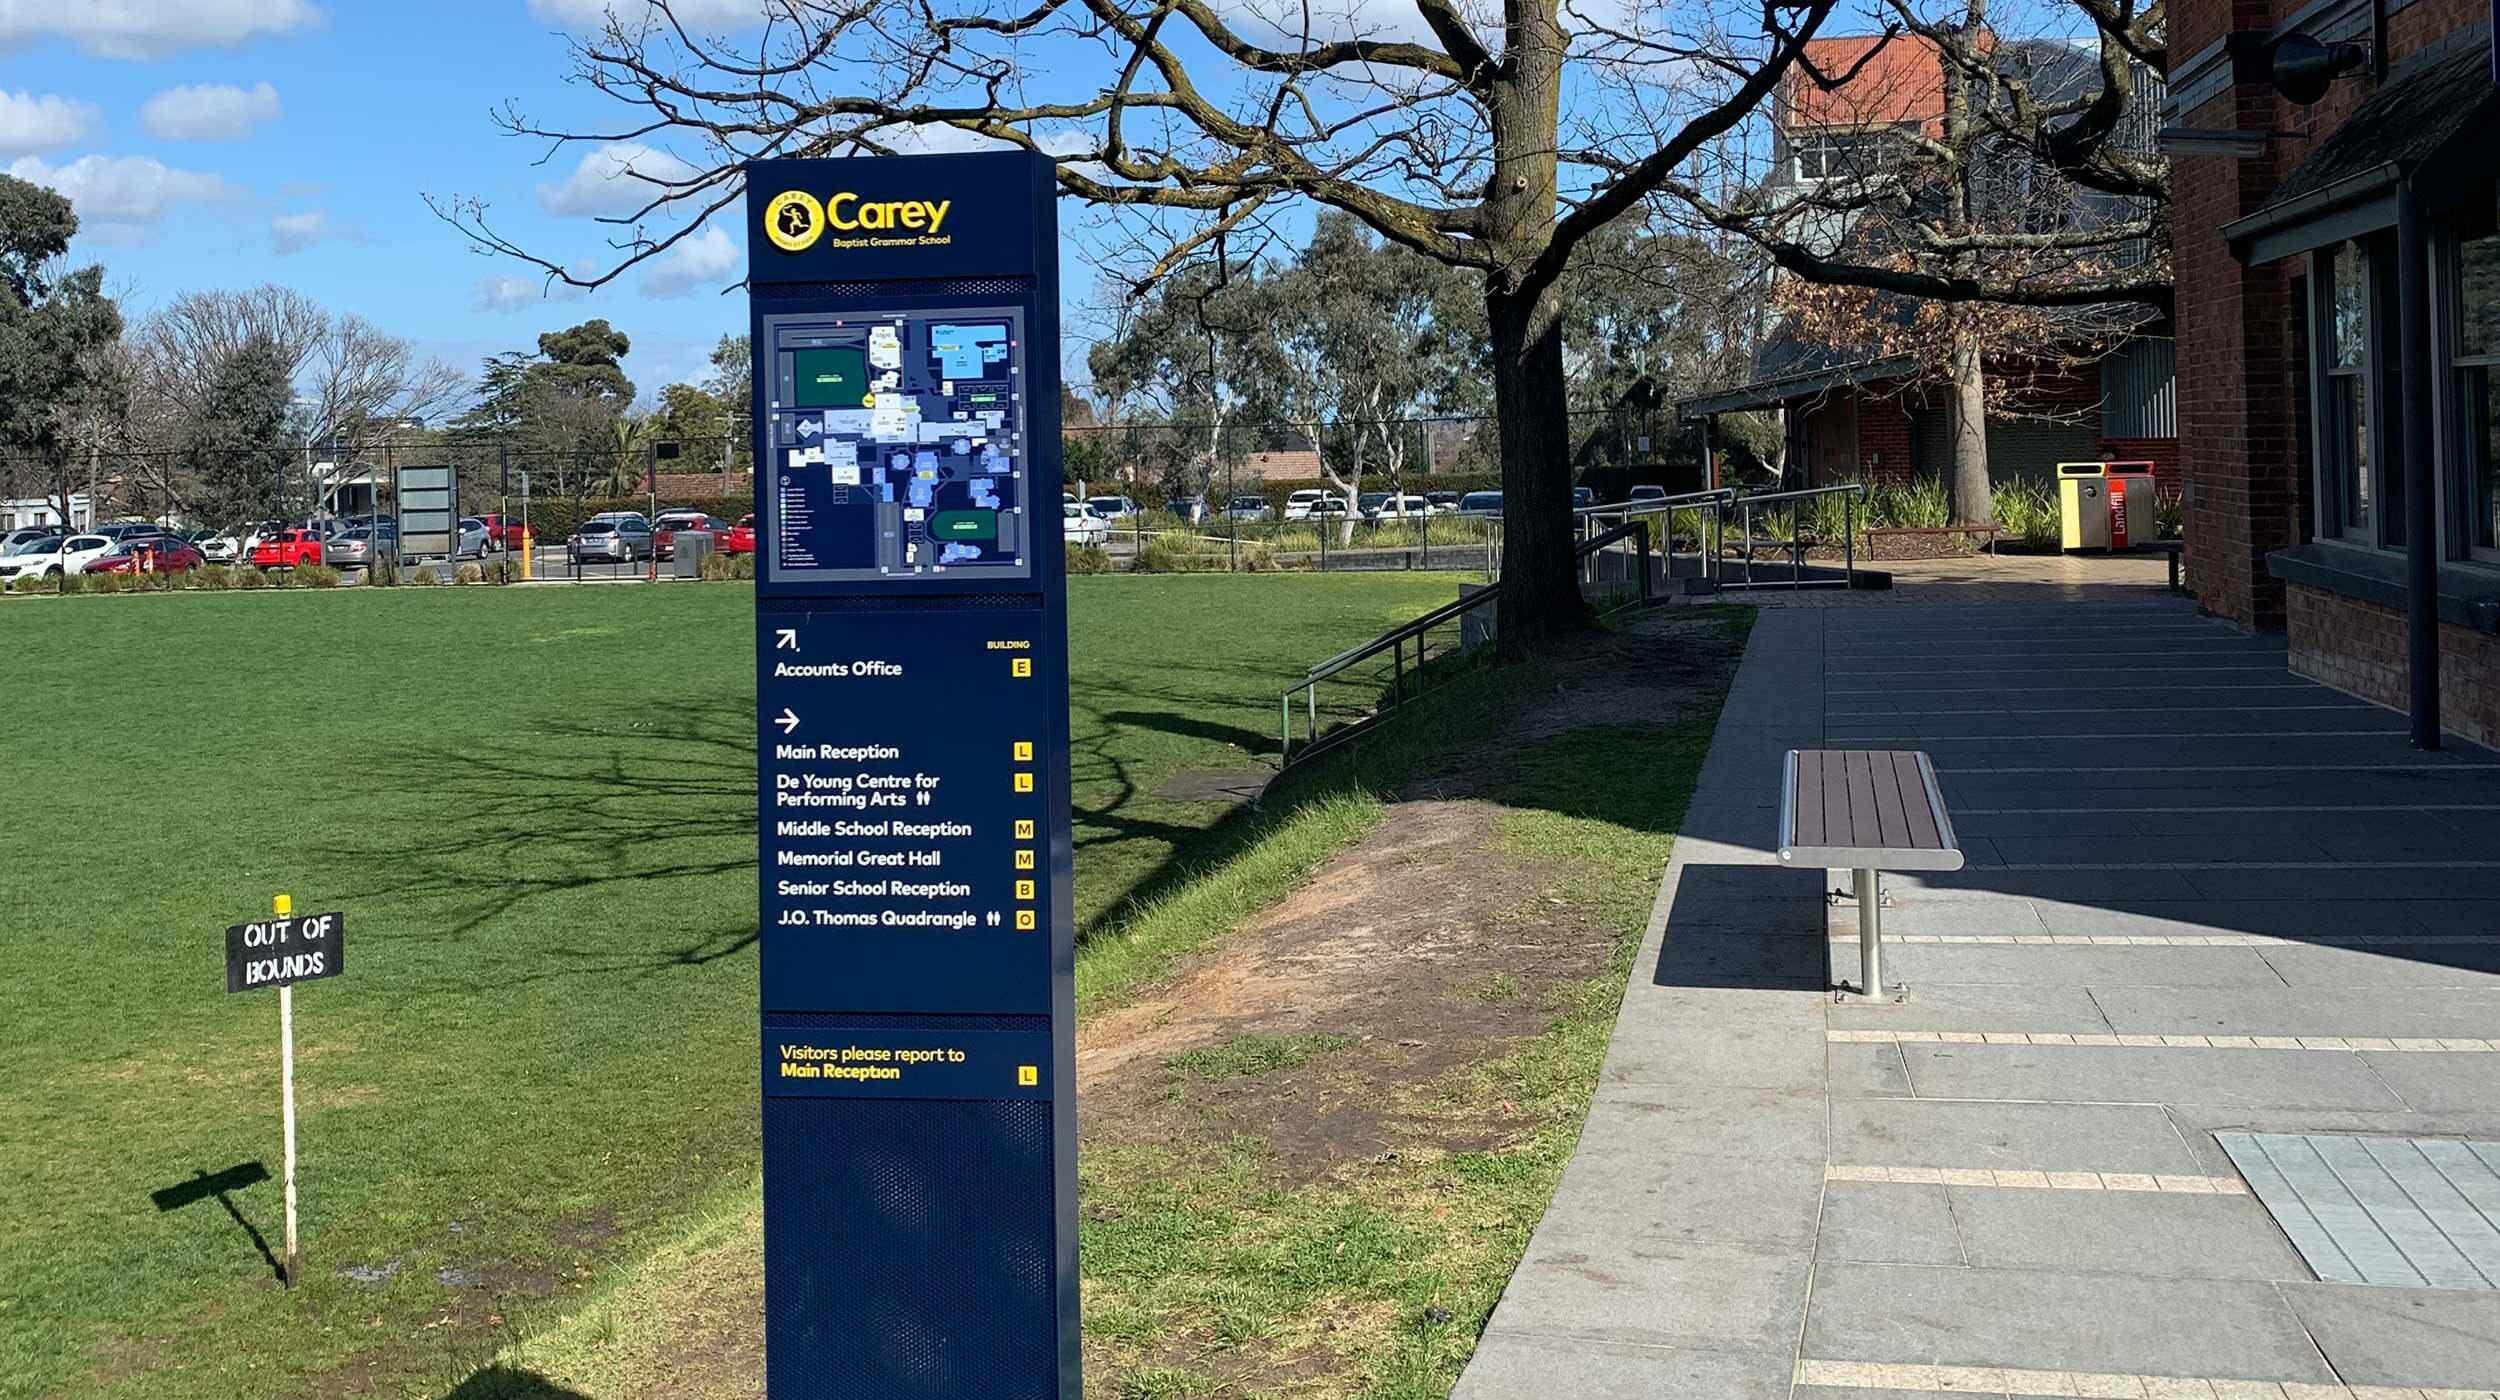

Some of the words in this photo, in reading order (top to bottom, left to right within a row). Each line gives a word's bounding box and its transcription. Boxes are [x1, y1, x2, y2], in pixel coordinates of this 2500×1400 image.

[827, 192, 951, 234] Carey
[834, 239, 869, 248] Baptist
[870, 238, 917, 246] Grammar
[918, 234, 951, 245] School
[2110, 491, 2126, 535] Landfill
[987, 641, 1030, 649] BUILDING
[775, 663, 848, 676] Accounts
[852, 661, 902, 675] Office
[1017, 661, 1027, 674] E
[777, 745, 816, 759] Main
[821, 744, 898, 762] Reception
[1019, 745, 1029, 758] L
[777, 775, 799, 789] De
[803, 774, 852, 793] Young
[857, 774, 911, 789] Centre
[915, 773, 940, 789] for
[1019, 776, 1029, 789] L
[777, 791, 866, 810] Performing
[870, 792, 906, 806] Arts
[778, 821, 831, 835] Middle
[835, 821, 888, 835] School
[893, 821, 971, 839] Reception
[1018, 823, 1031, 836] M
[778, 851, 853, 865] Memorial
[857, 851, 905, 865] Great
[909, 851, 940, 865] Hall
[1018, 853, 1032, 866] M
[779, 881, 829, 895] Senior
[833, 881, 886, 895] School
[891, 881, 970, 899] Reception
[1020, 883, 1030, 896] B
[778, 910, 809, 925] J.O.
[813, 910, 877, 925] Thomas
[882, 911, 976, 929] Quadrangle
[244, 920, 292, 948] OUT
[302, 915, 332, 940] OF
[246, 951, 325, 985] BOUNDS
[781, 1045, 839, 1061] Visitors
[842, 1046, 891, 1066] please
[895, 1049, 944, 1064] report
[947, 1049, 965, 1062] to
[782, 1063, 820, 1077] Main
[824, 1062, 899, 1081] Reception
[1023, 1069, 1033, 1082] L
